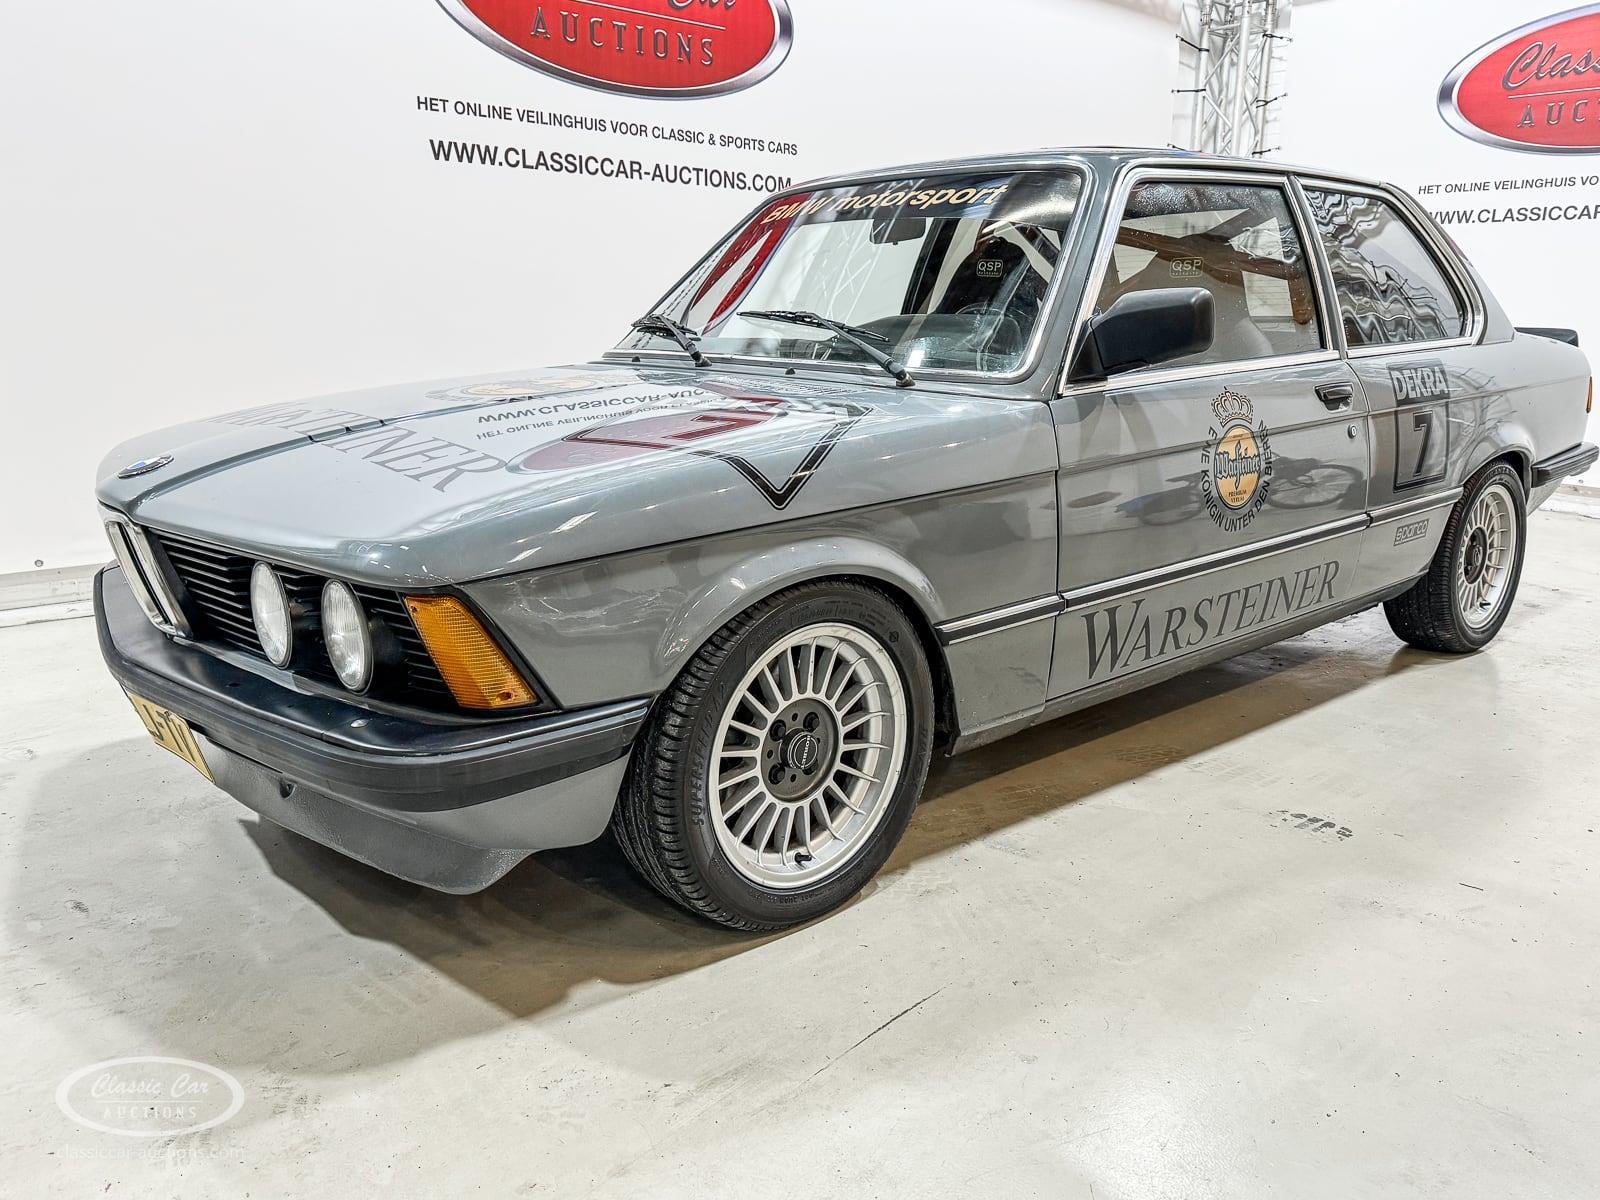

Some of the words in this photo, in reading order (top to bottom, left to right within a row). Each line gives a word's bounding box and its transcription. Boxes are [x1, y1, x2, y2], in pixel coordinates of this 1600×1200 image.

[530, 7, 715, 65] AUCTIONS
[416, 96, 449, 113] HET
[453, 100, 513, 121] ONLINE
[516, 108, 607, 132] VEILINGHUIS
[610, 120, 648, 138] VOOR
[652, 126, 705, 145] CLASSIC
[708, 133, 716, 146] &
[719, 135, 765, 152] SPORTS
[768, 141, 798, 156] CARS
[1517, 100, 1600, 128] AUC
[429, 139, 791, 193] WWW.CLASSICCAR-AUCTIONS.COM
[1418, 184, 1441, 195] HET
[1444, 181, 1491, 193] ONLINE
[1493, 176, 1576, 191] VEILINGHUIS
[760, 195, 834, 225] BMW
[830, 184, 1008, 212] motorsport
[978, 261, 1002, 272] QSP
[1172, 260, 1201, 271] QSP
[1391, 366, 1449, 401] DEKRA
[1413, 410, 1433, 478] 7
[1201, 469, 1224, 528] KÖNIGIN
[1224, 511, 1255, 532] UNTER
[1255, 480, 1270, 512] DEN
[1081, 560, 1340, 680] WARSTEINER
